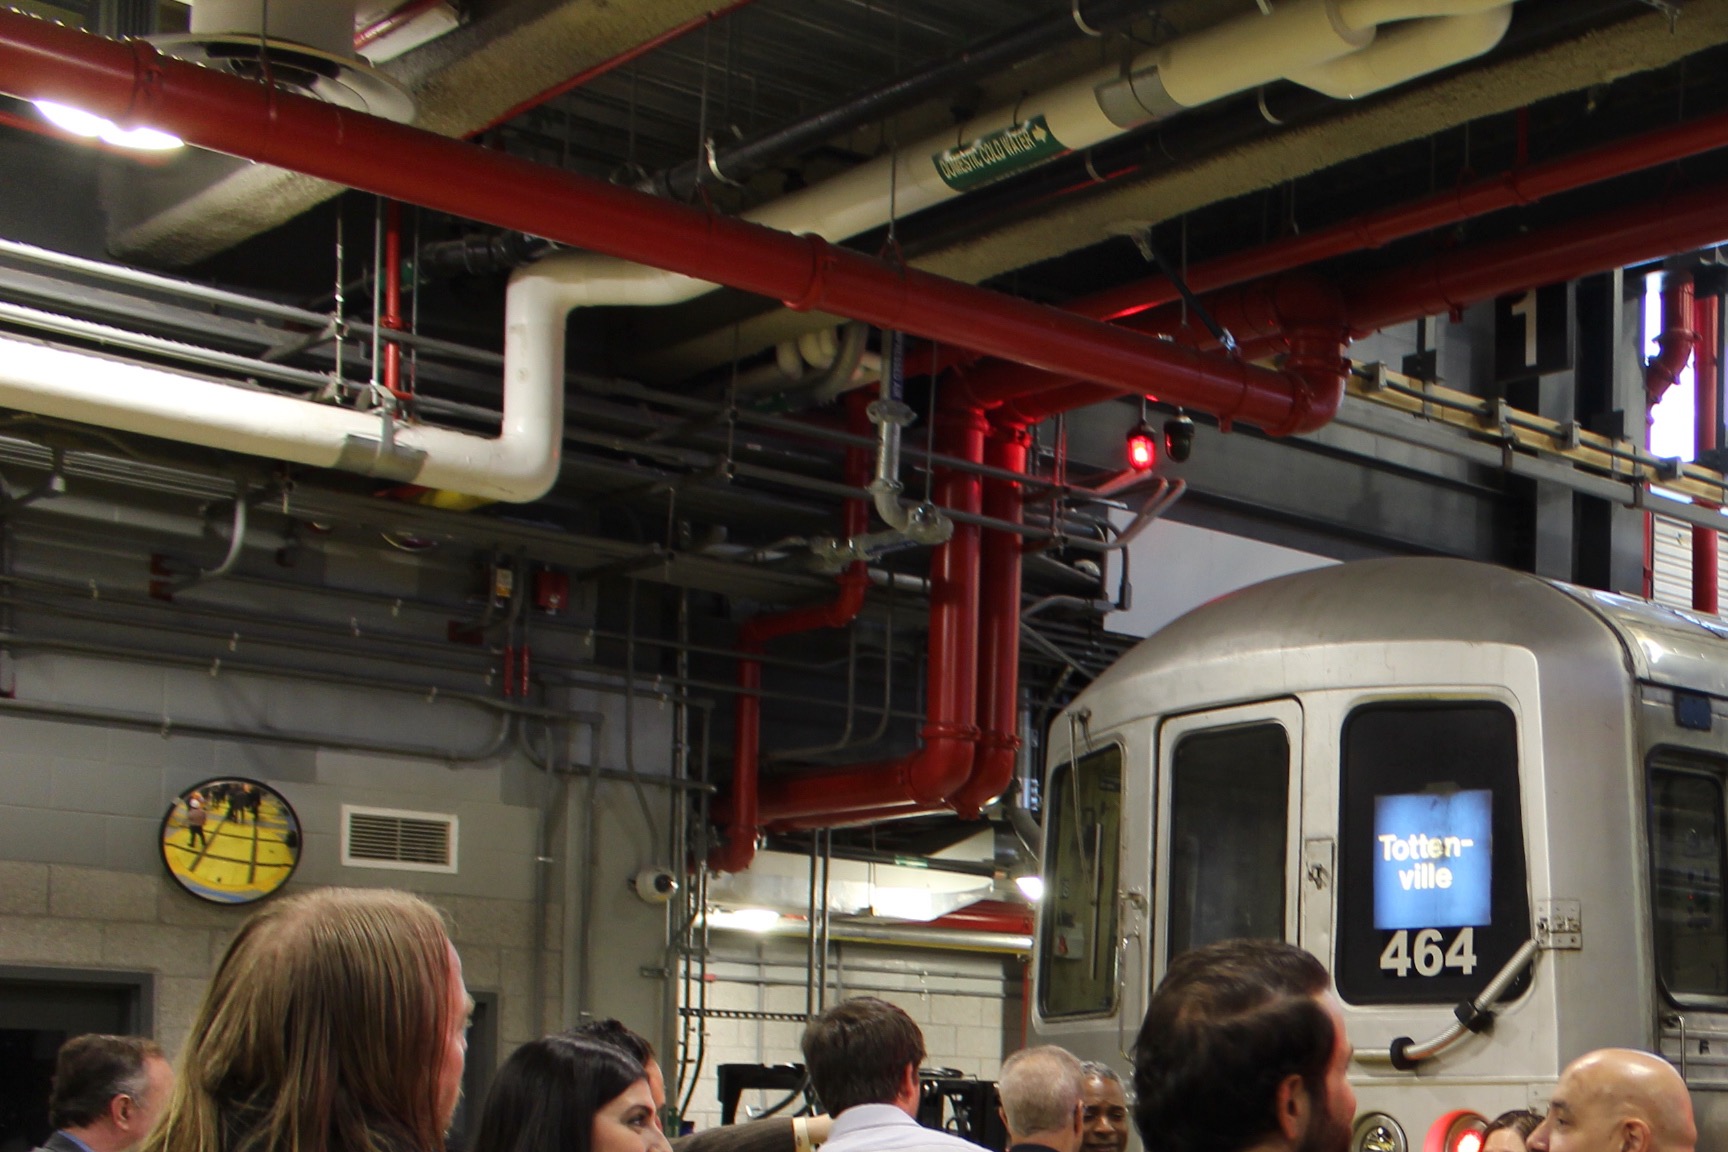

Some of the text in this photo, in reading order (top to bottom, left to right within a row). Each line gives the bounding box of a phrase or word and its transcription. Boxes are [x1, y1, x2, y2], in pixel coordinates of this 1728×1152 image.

[939, 128, 1036, 179] DOMESTIC COLD WATER
[1511, 287, 1537, 368] 1
[1378, 833, 1474, 861] Totten-
[1399, 862, 1454, 891] ville
[1379, 927, 1478, 977] 464
